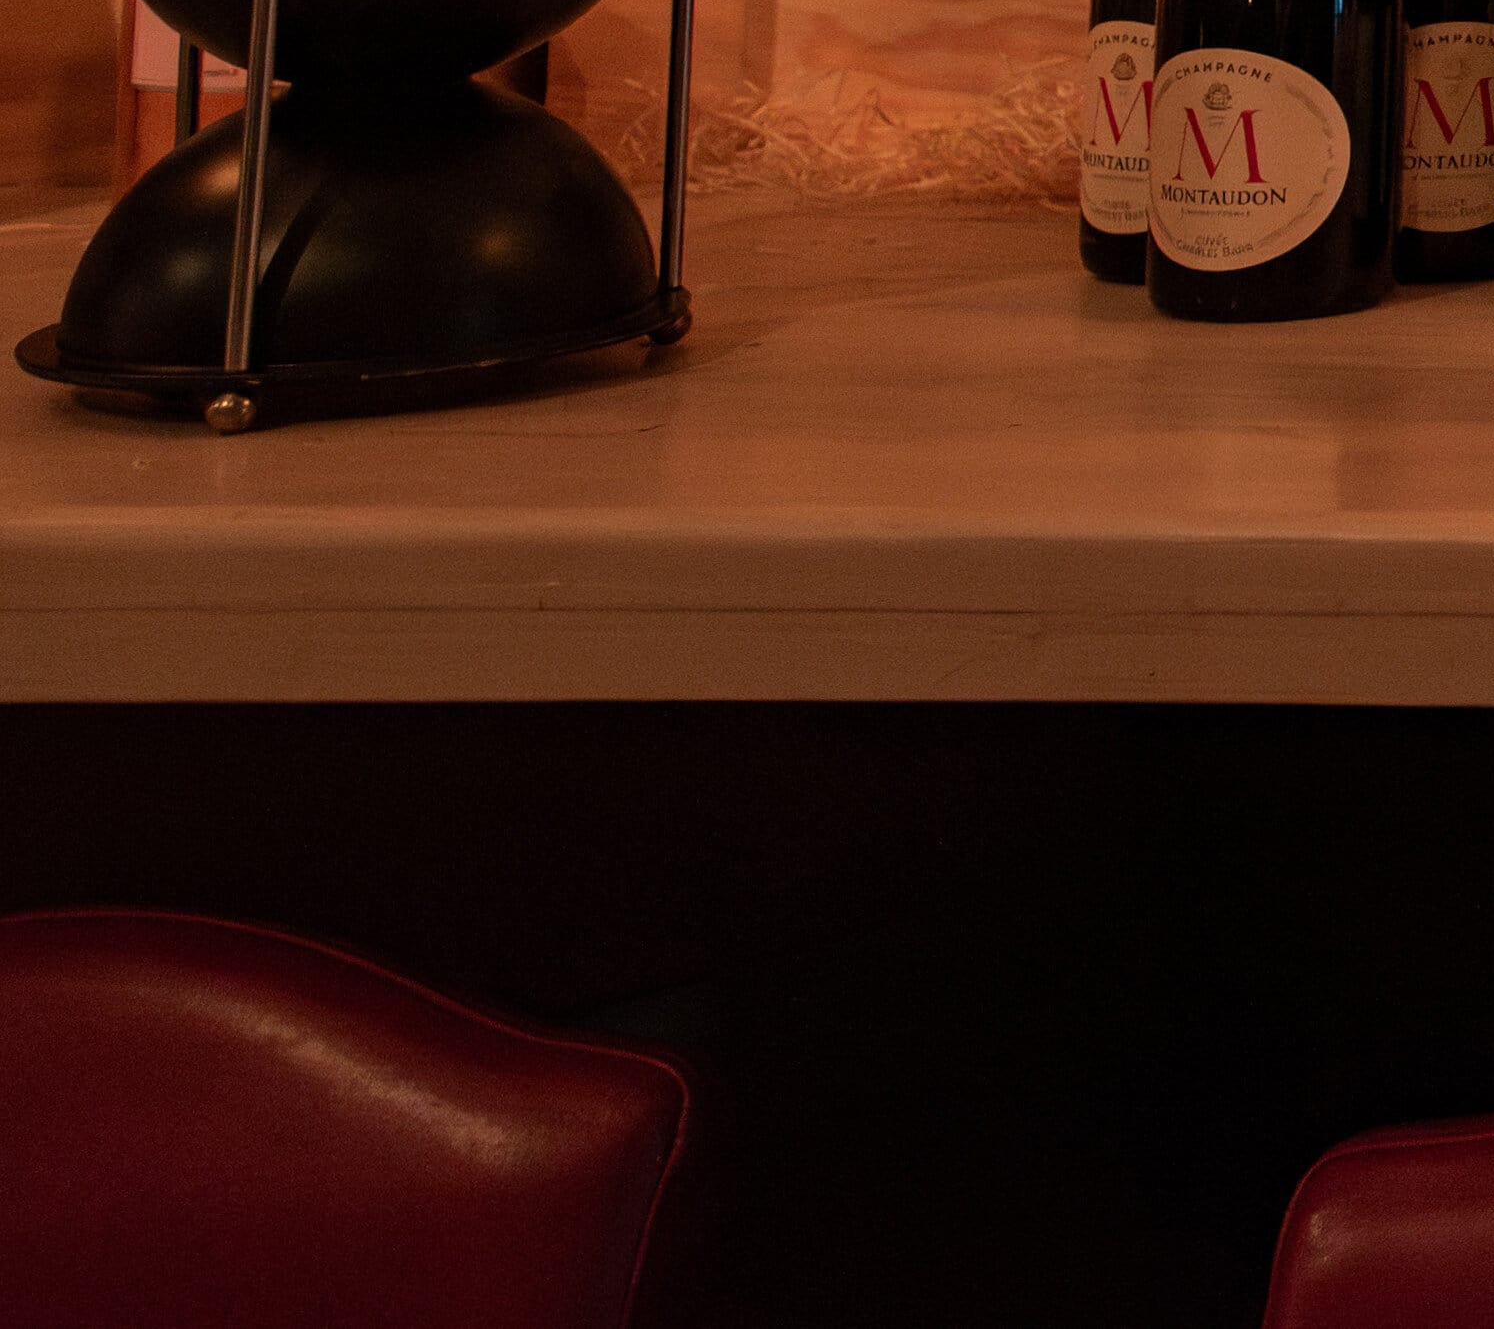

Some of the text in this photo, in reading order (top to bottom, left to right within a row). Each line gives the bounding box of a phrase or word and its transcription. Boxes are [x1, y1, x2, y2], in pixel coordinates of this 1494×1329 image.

[1174, 60, 1274, 84] CHAMPAGNE
[1171, 106, 1268, 185] M
[1159, 183, 1288, 207] MONTAUDON
